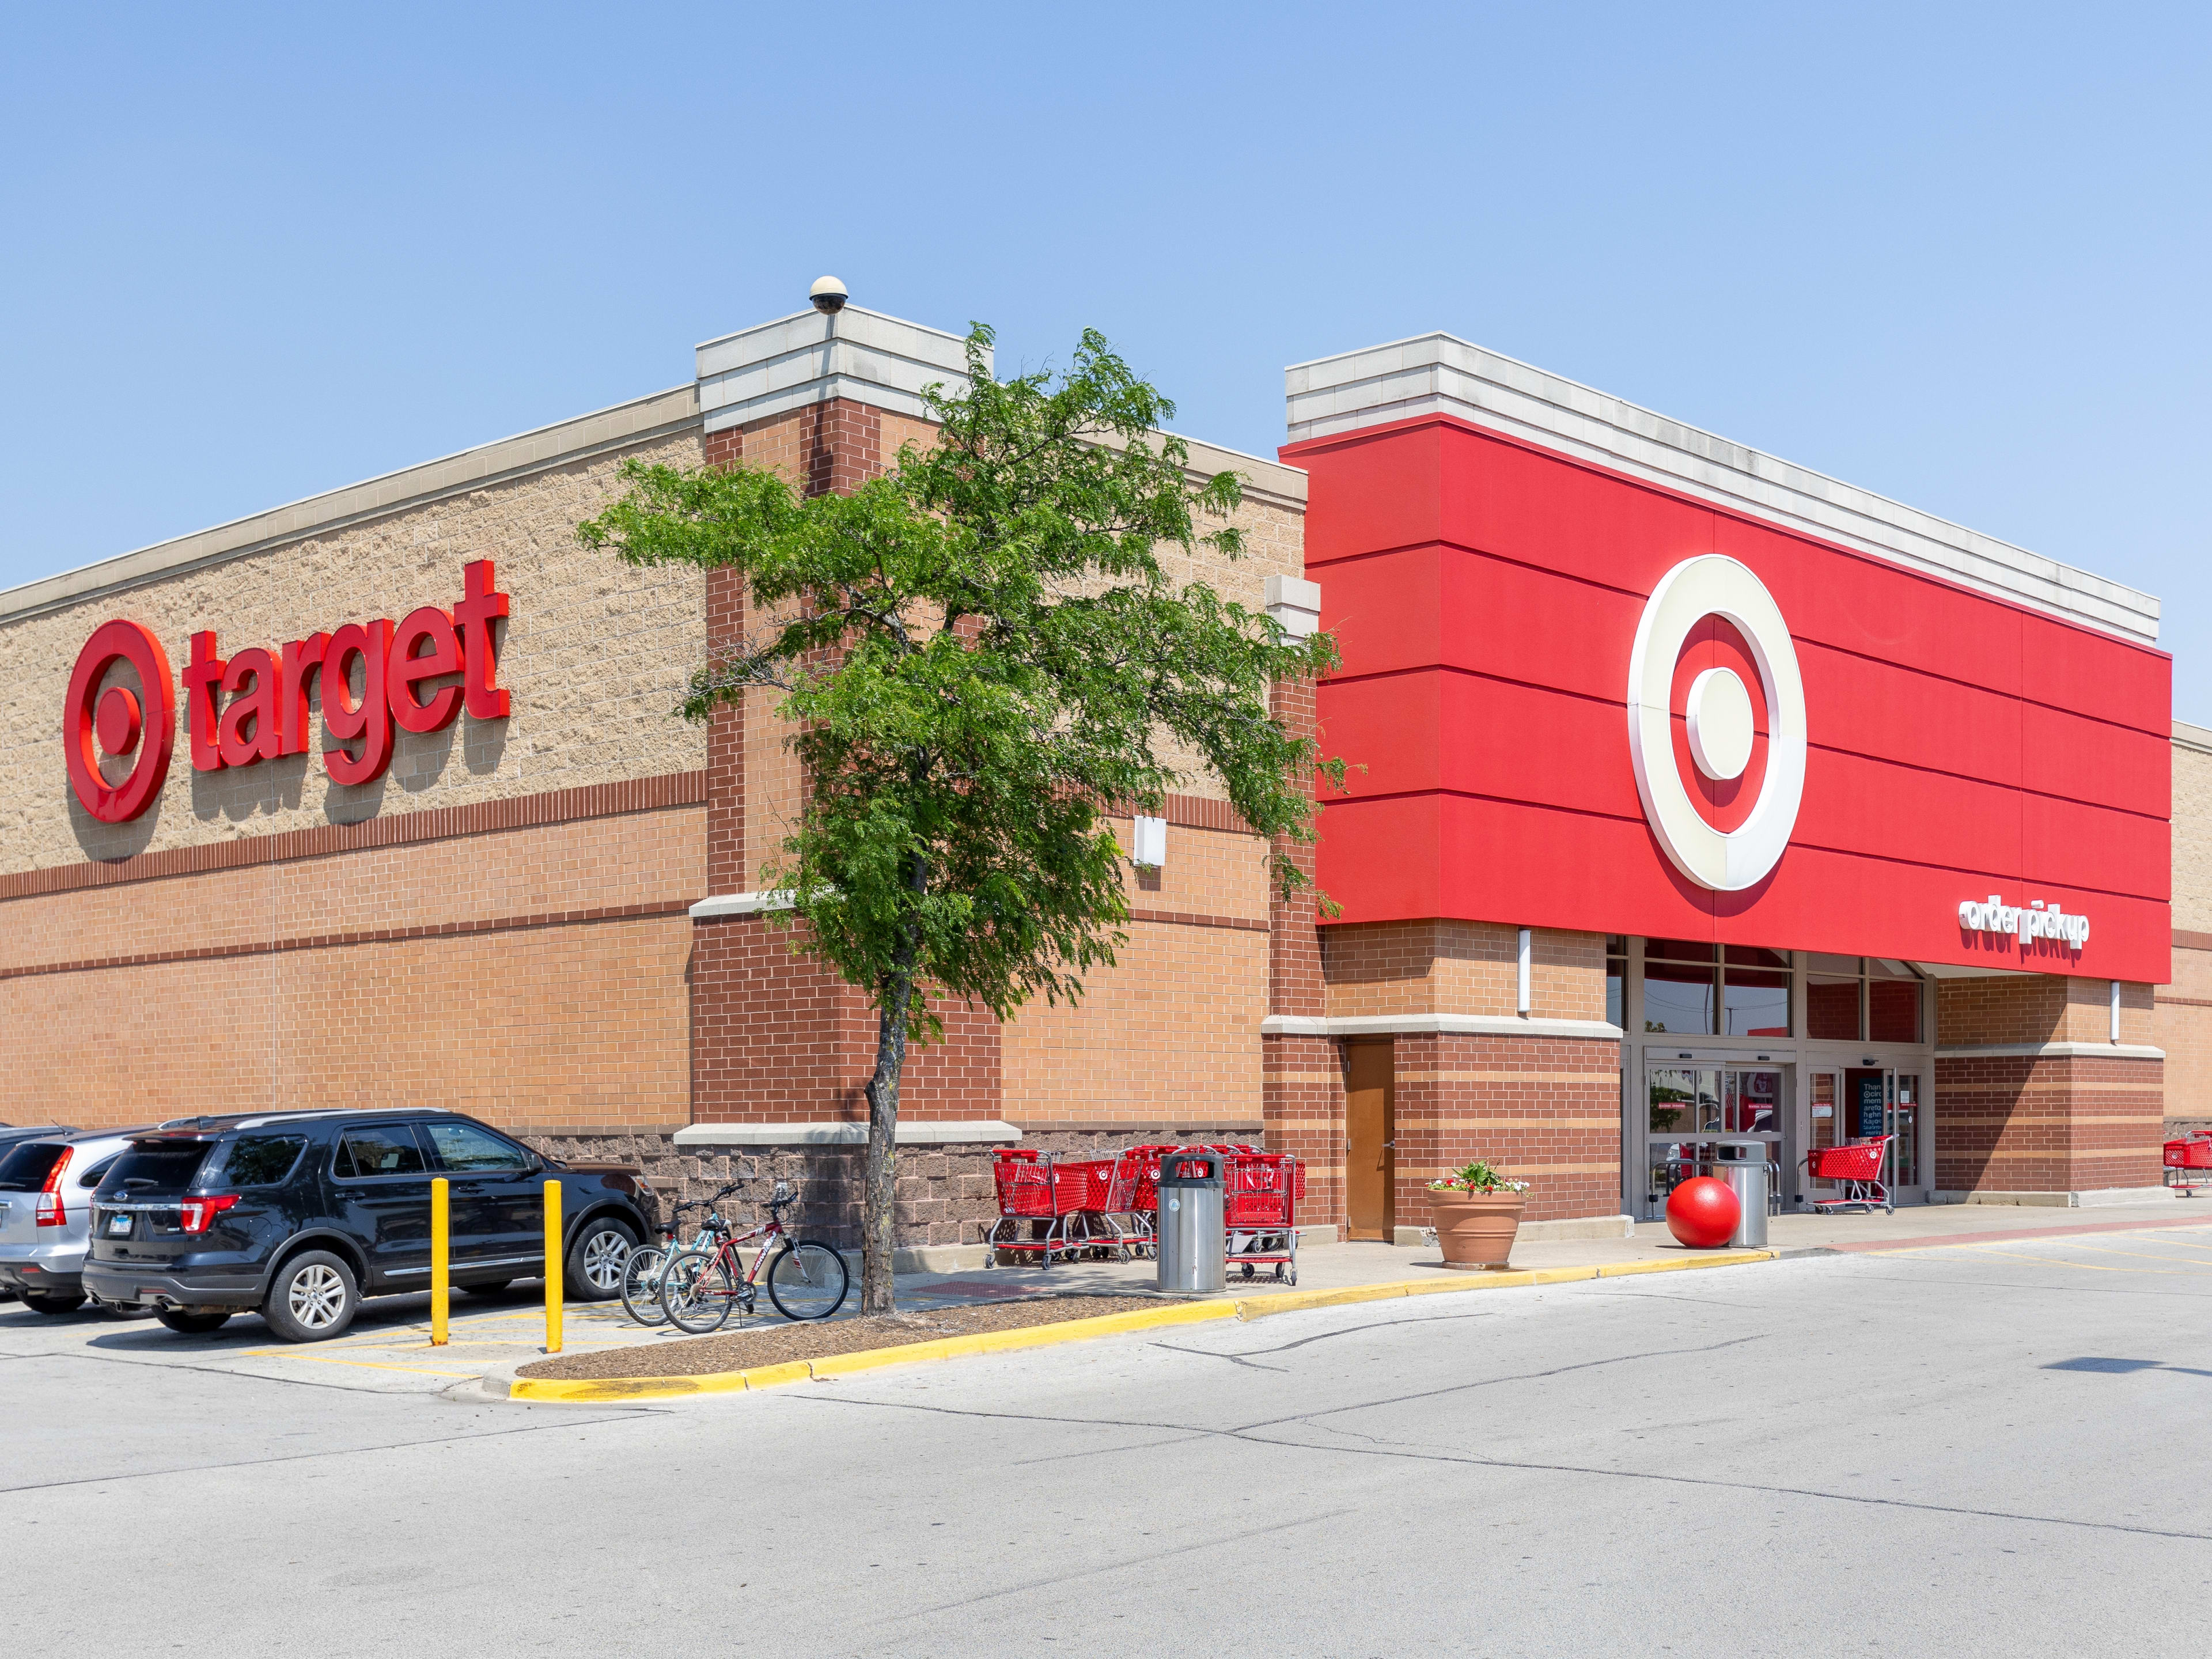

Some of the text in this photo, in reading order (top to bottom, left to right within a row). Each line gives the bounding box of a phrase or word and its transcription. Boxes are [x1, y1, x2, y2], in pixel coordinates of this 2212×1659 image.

[182, 559, 510, 785] target
[1959, 895, 2089, 949] order pickup
[754, 1230, 777, 1271] SCHWINN
